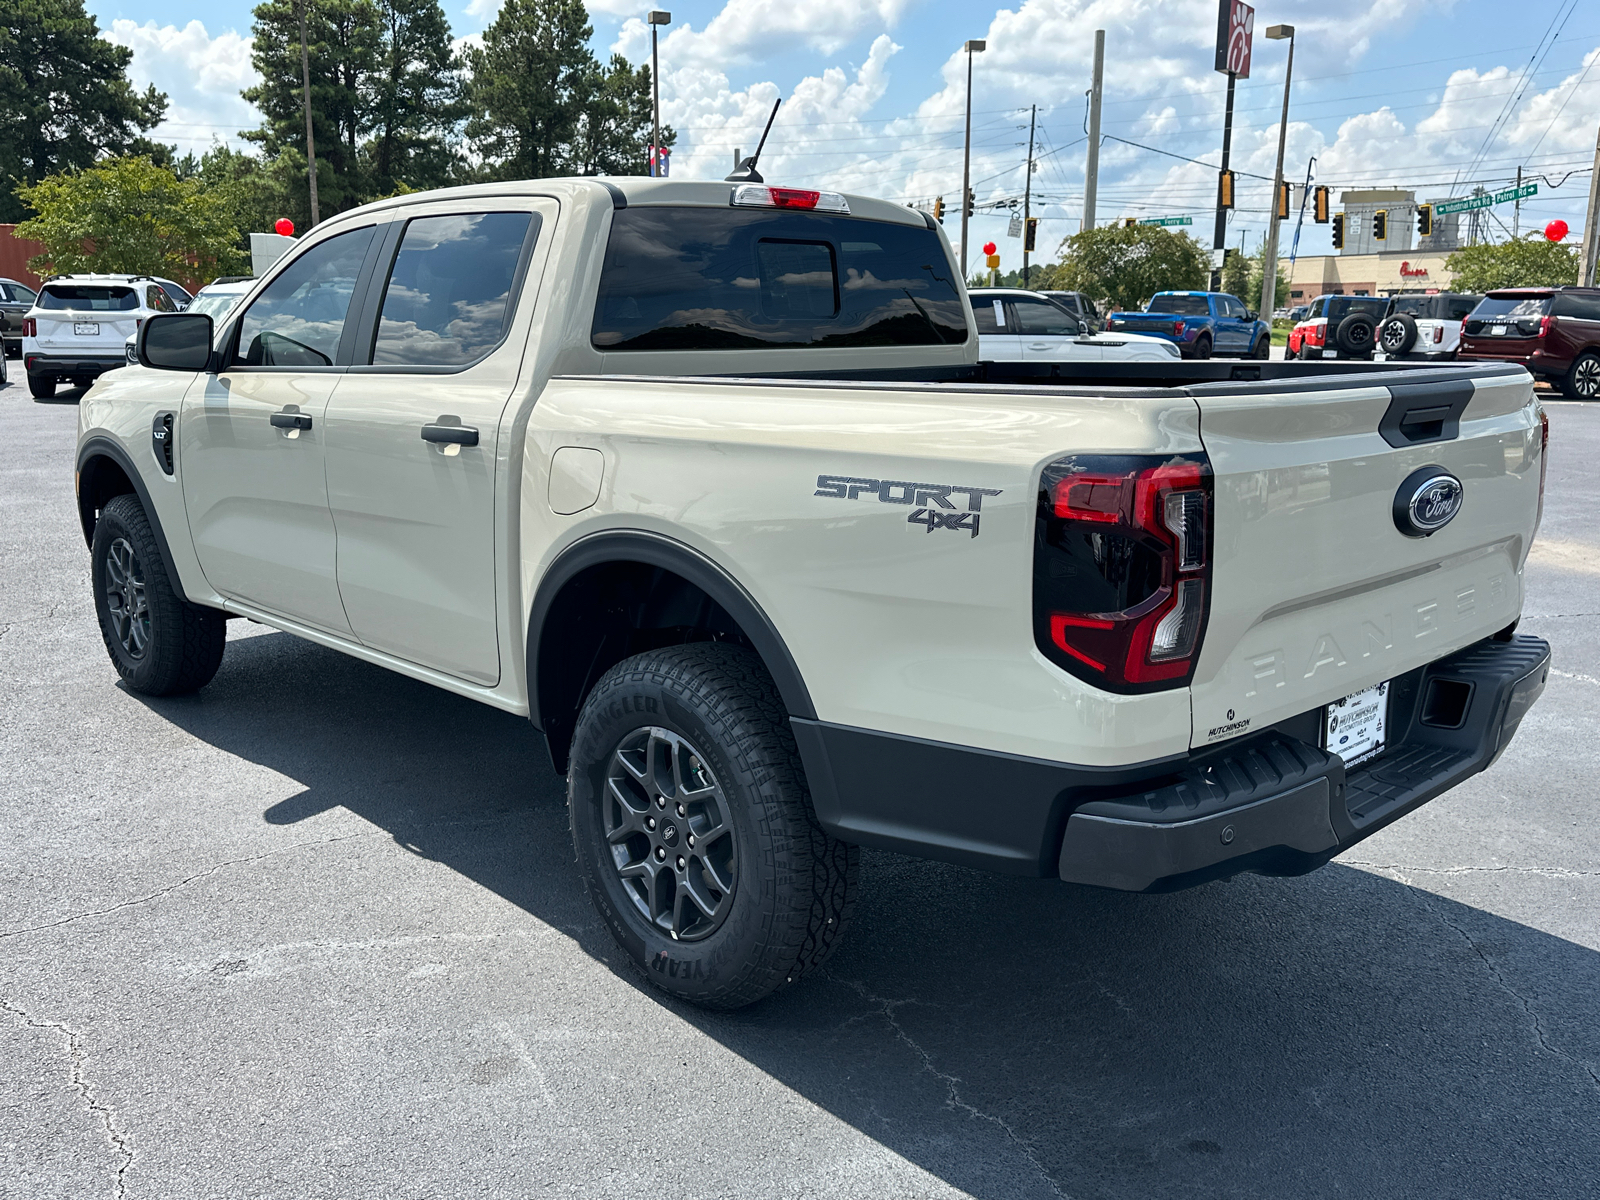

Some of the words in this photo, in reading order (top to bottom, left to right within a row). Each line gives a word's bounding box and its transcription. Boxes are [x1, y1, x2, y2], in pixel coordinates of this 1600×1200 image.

[1445, 201, 1468, 213] Industrial
[1469, 199, 1481, 209] Park
[1482, 197, 1490, 206] Rd
[1497, 191, 1515, 203] Patrol
[1518, 188, 1527, 197] Rd
[1164, 218, 1180, 226] Ferry
[813, 474, 1004, 513] SPORT
[1425, 487, 1456, 519] Ford
[907, 508, 981, 539] 4x4
[1244, 572, 1508, 698] RANGER
[1208, 717, 1251, 737] HUTCHINSON
[1339, 702, 1380, 727] HUTCHINSON
